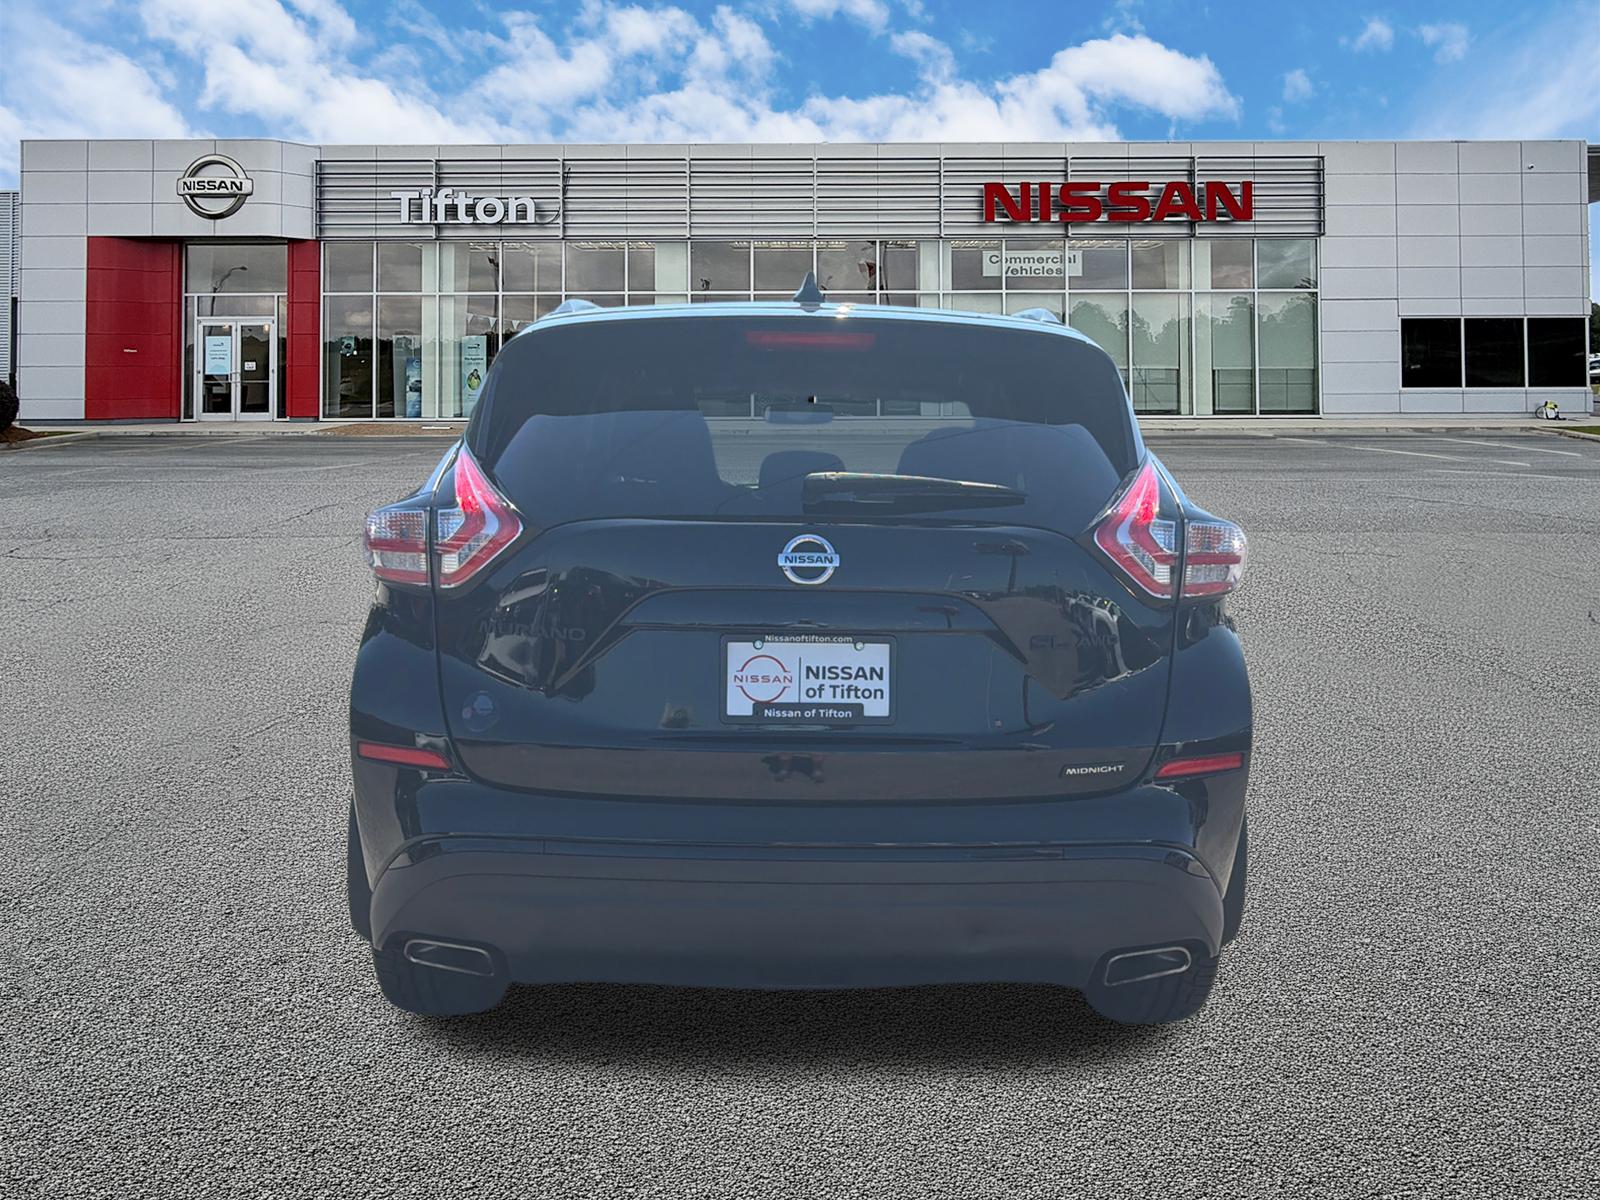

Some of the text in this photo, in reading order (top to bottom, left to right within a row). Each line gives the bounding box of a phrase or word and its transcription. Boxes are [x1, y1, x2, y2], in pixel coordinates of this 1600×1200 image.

[182, 180, 243, 191] NISSAN
[390, 187, 536, 224] Tifton
[984, 181, 1254, 222] NISSAN
[784, 555, 834, 564] NISSAN
[479, 619, 587, 641] MURANO
[764, 634, 853, 643] Nissanoftifton.com
[805, 665, 884, 681] NISSAN
[733, 675, 793, 684] NISSAN
[805, 684, 884, 700] of Tifton
[764, 708, 852, 719] Nissan of Tifton
[1066, 765, 1125, 775] MIDNIGHT
